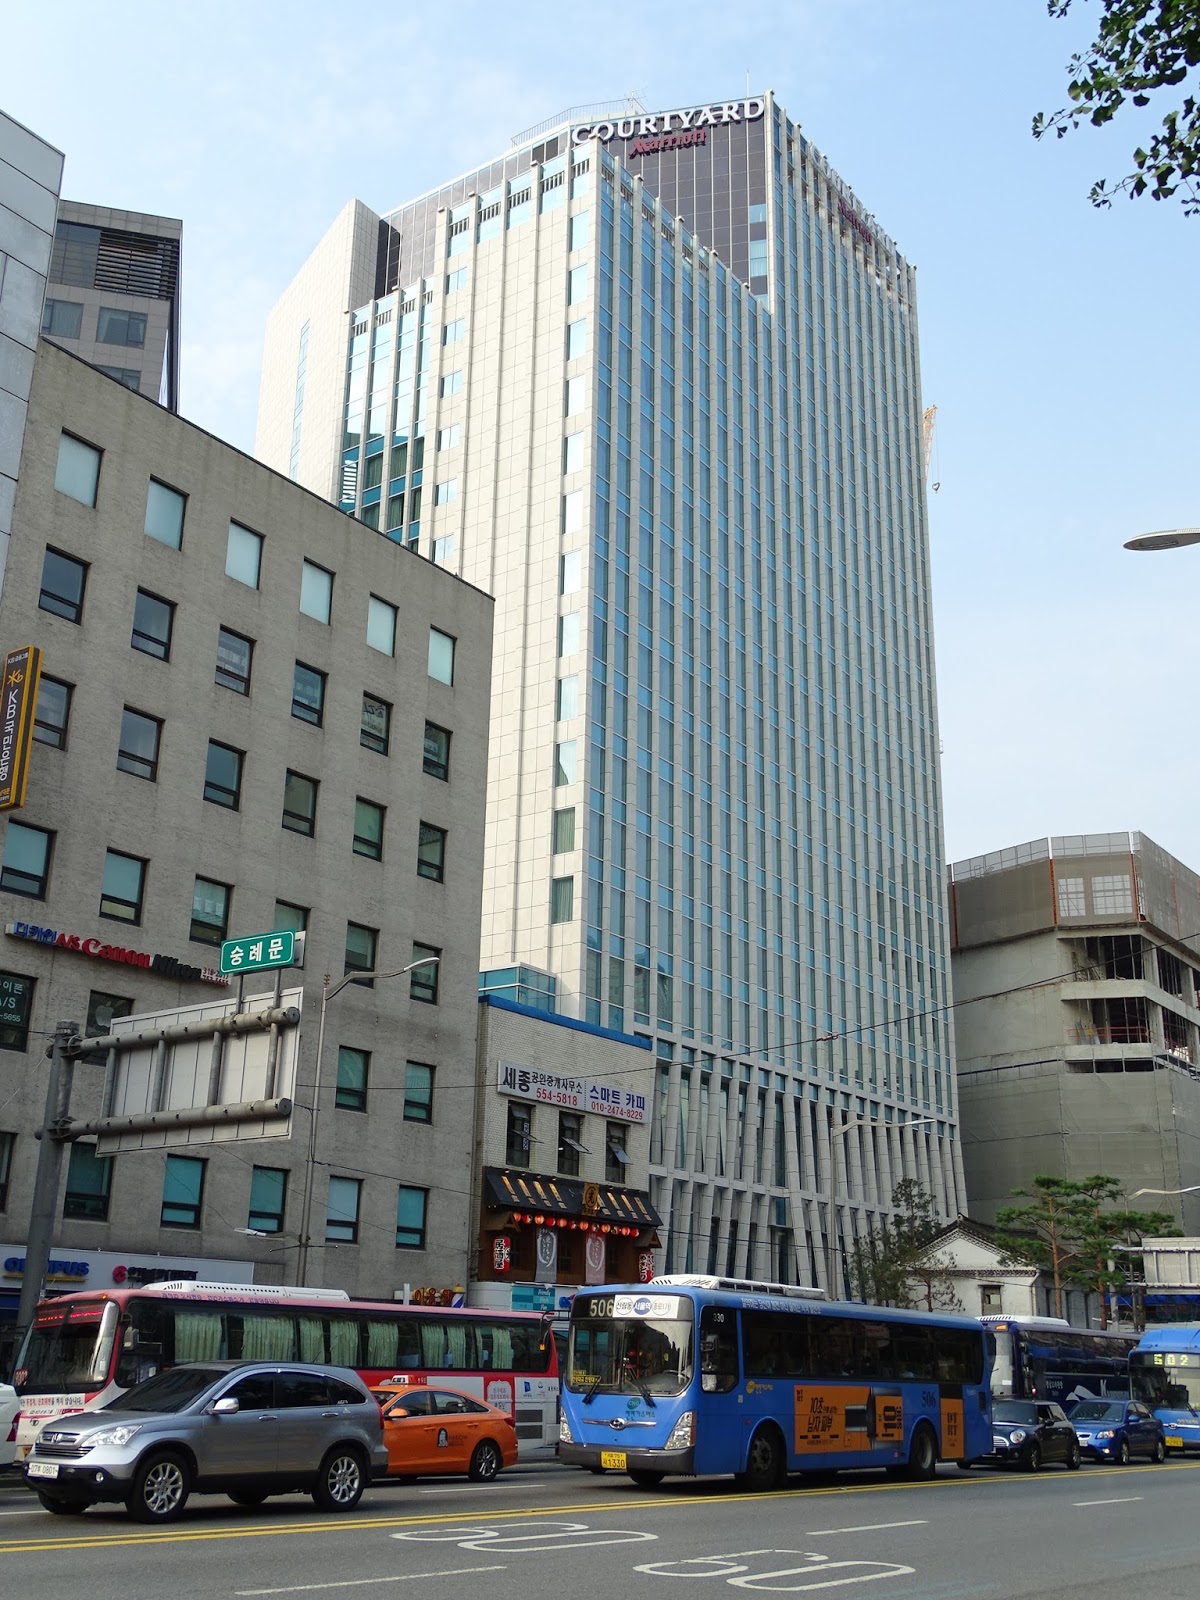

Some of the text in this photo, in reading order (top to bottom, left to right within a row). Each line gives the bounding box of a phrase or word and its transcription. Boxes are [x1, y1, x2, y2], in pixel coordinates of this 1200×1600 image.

[572, 98, 765, 145] COURTYARD
[629, 128, 707, 158] Marriott
[82, 938, 151, 968] Canon
[152, 953, 202, 981] Nikon
[229, 938, 284, 966] 숭례문
[0, 980, 23, 995] 이폰
[502, 1066, 583, 1095] 세종 공인중개사무소
[536, 1087, 578, 1106] 554-5818
[589, 1085, 621, 1105] 스마트
[591, 1101, 644, 1120] 010-2474-8229
[589, 1299, 615, 1318] 506
[634, 1301, 652, 1311] 서울역
[1153, 1353, 1190, 1366] 502
[608, 1458, 626, 1468] 1330
